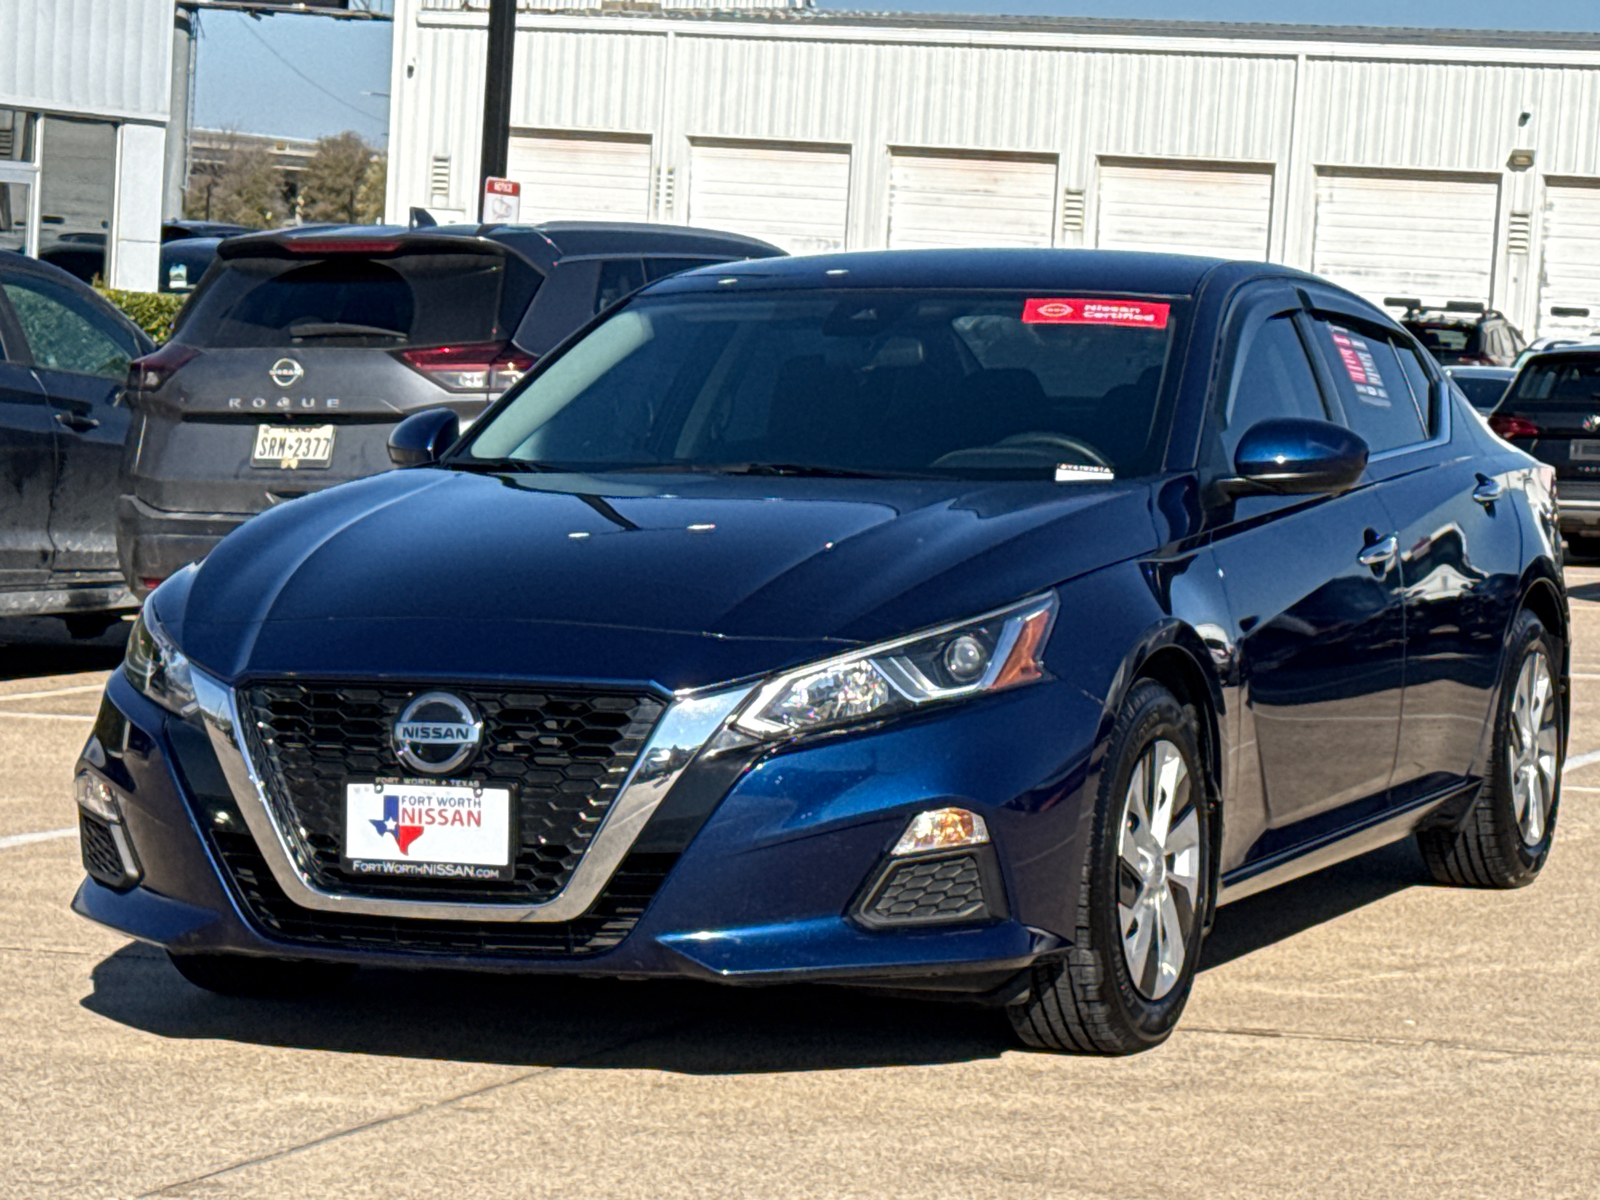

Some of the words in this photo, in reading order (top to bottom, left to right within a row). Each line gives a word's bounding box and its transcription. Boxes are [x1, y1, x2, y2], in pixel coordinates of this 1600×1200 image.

[1084, 304, 1140, 313] Nissan
[1082, 311, 1155, 322] Certified
[229, 397, 339, 408] ROGUE
[294, 437, 331, 457] 2377
[402, 726, 469, 740] NISSAN
[403, 777, 436, 786] WORTH
[450, 779, 480, 788] TEXAS
[401, 795, 433, 807] FORT
[436, 796, 482, 809] WORTH
[401, 807, 482, 828] NISSAN
